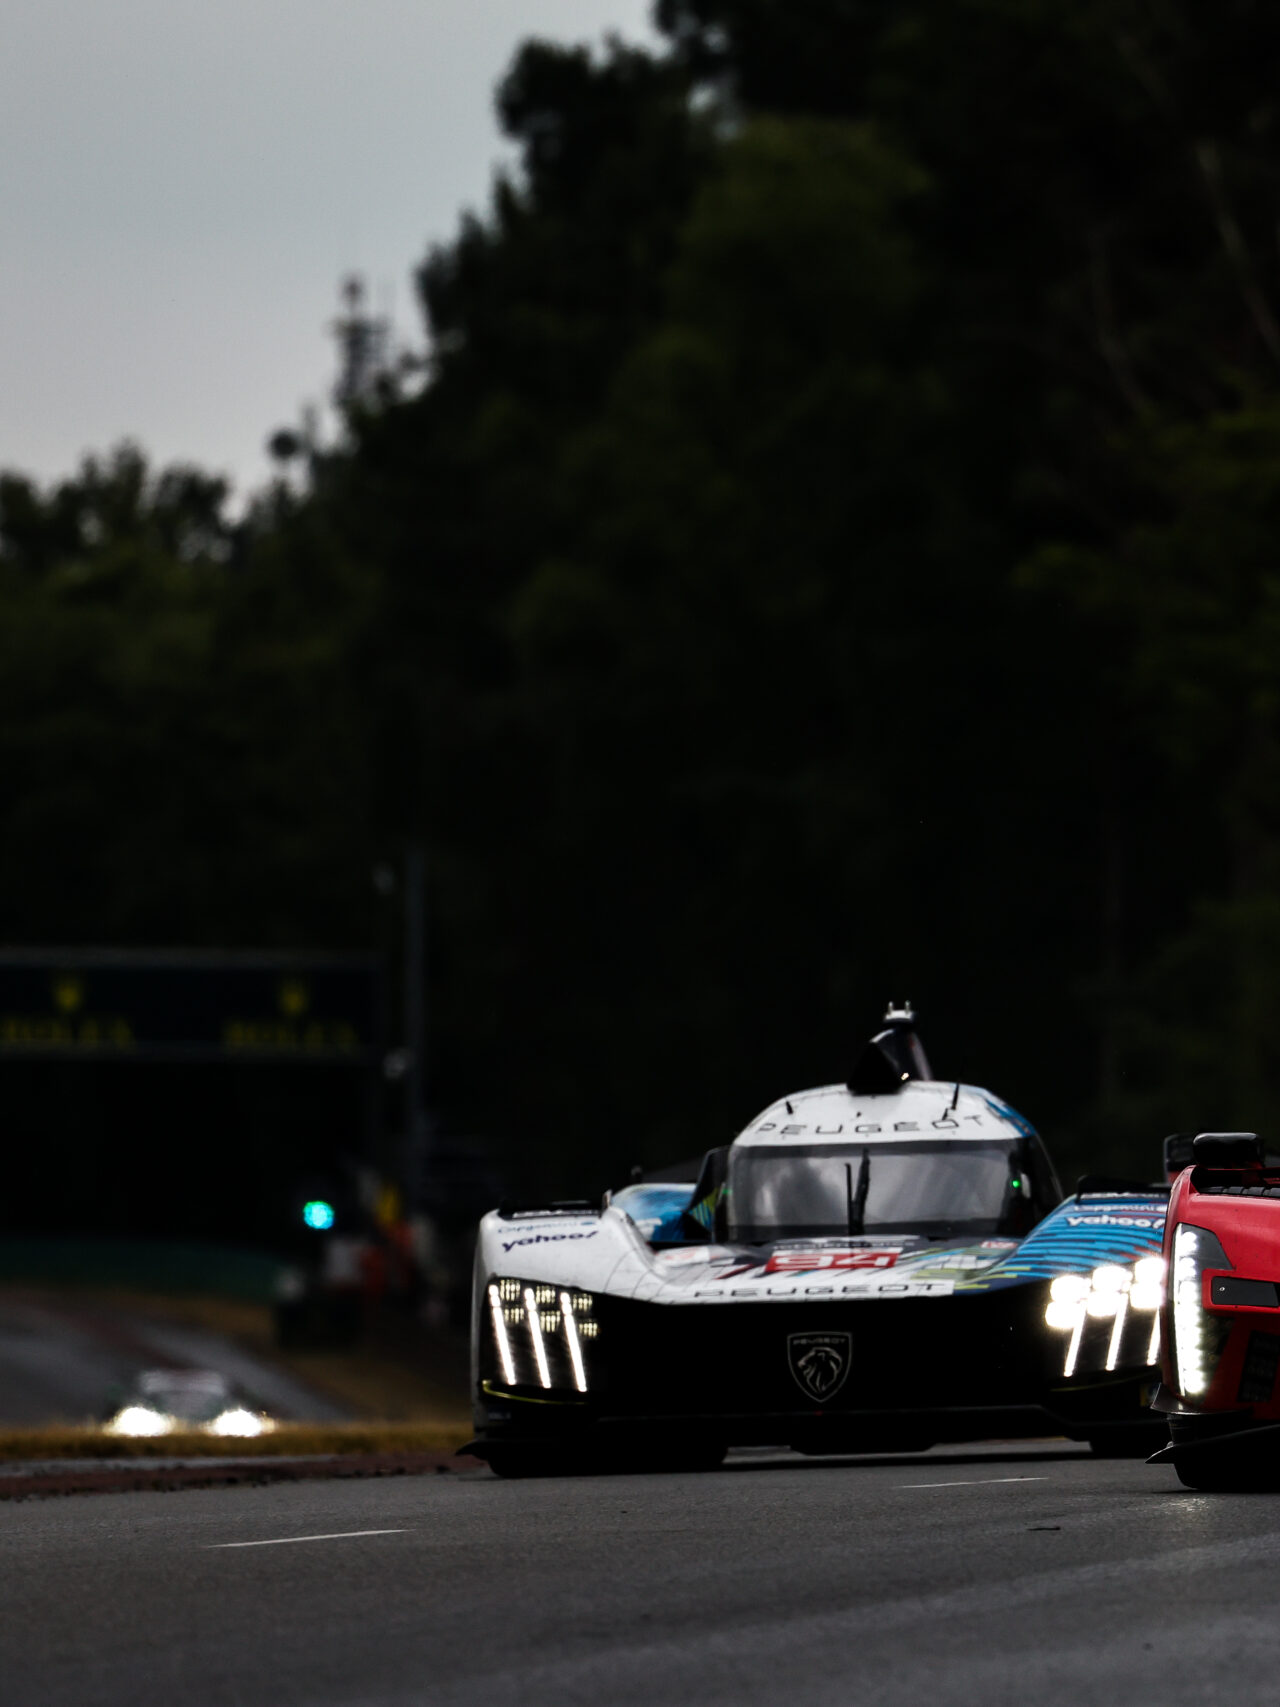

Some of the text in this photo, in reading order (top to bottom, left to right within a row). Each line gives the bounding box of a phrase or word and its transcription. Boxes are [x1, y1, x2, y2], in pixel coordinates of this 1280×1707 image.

[756, 1115, 986, 1135] PEUGEOT
[774, 1253, 891, 1269] 94
[694, 1283, 945, 1297] PEUGEOT
